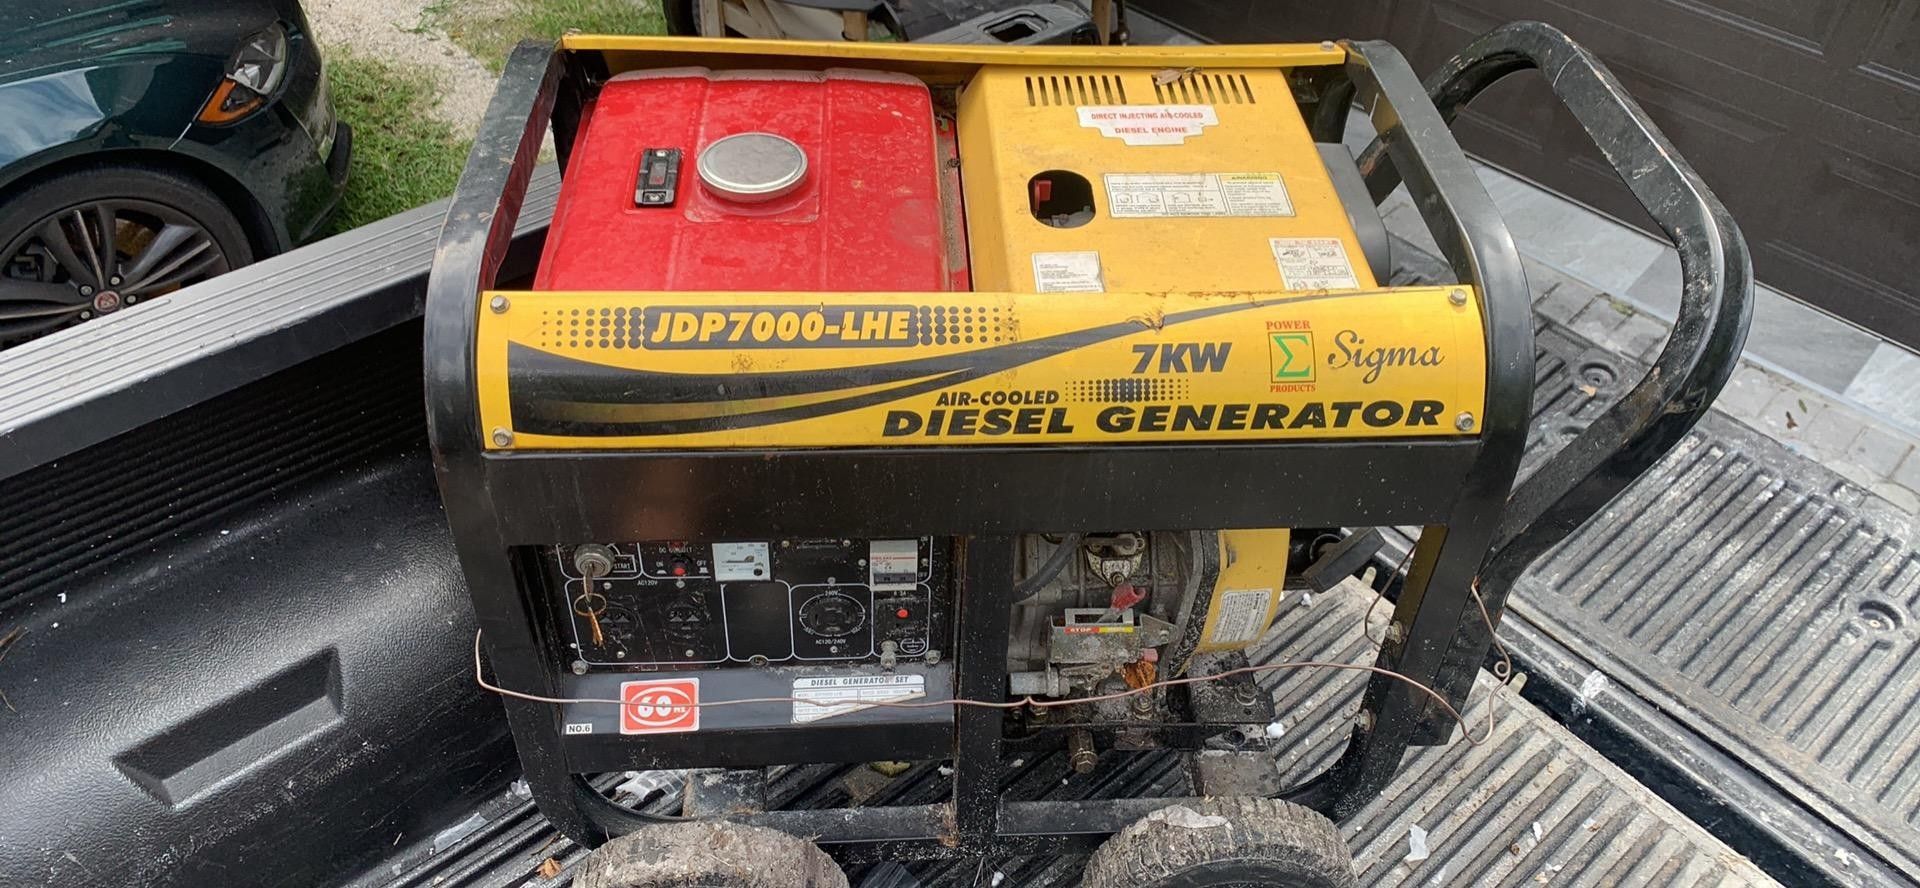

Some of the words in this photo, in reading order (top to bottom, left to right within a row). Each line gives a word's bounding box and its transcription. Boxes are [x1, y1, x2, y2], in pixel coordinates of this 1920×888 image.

[1151, 126, 1188, 134] ENGINE
[651, 311, 911, 342] JDP7000-LHE
[1265, 320, 1311, 330] POWER
[1131, 342, 1232, 373] 7KW
[1327, 330, 1446, 384] Sigma
[936, 390, 1060, 407] AIR-COOLED
[1269, 383, 1316, 393] PRODUCTS
[882, 406, 1075, 437] DIESEL
[1096, 399, 1445, 433] GENERATOR
[637, 695, 672, 718] 60
